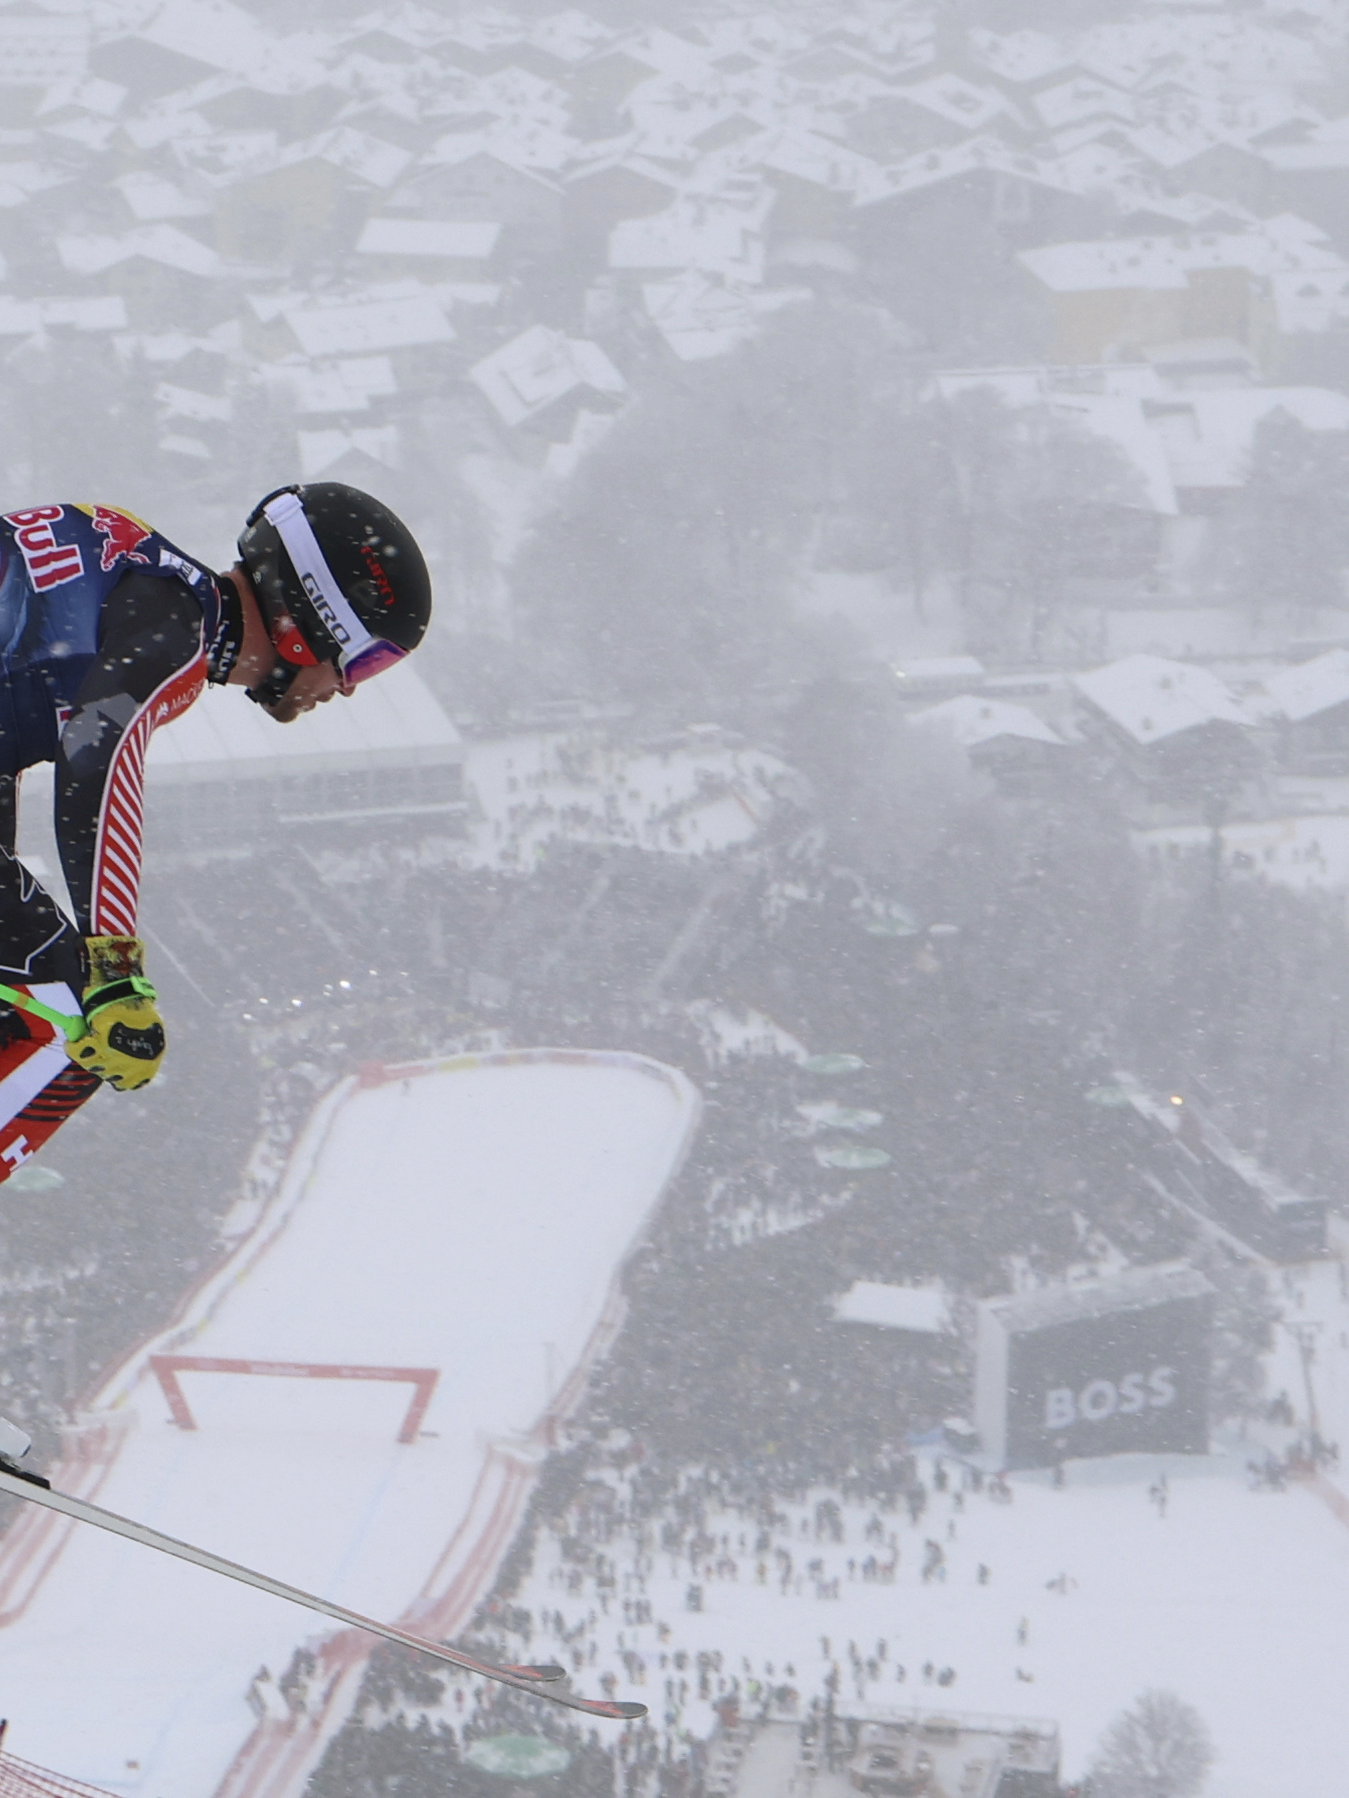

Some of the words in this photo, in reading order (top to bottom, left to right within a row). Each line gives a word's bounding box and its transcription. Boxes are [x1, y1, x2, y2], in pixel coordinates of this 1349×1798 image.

[2, 505, 84, 593] Bull
[301, 572, 351, 645] GIRO
[1045, 1367, 1178, 1430] BOSS
